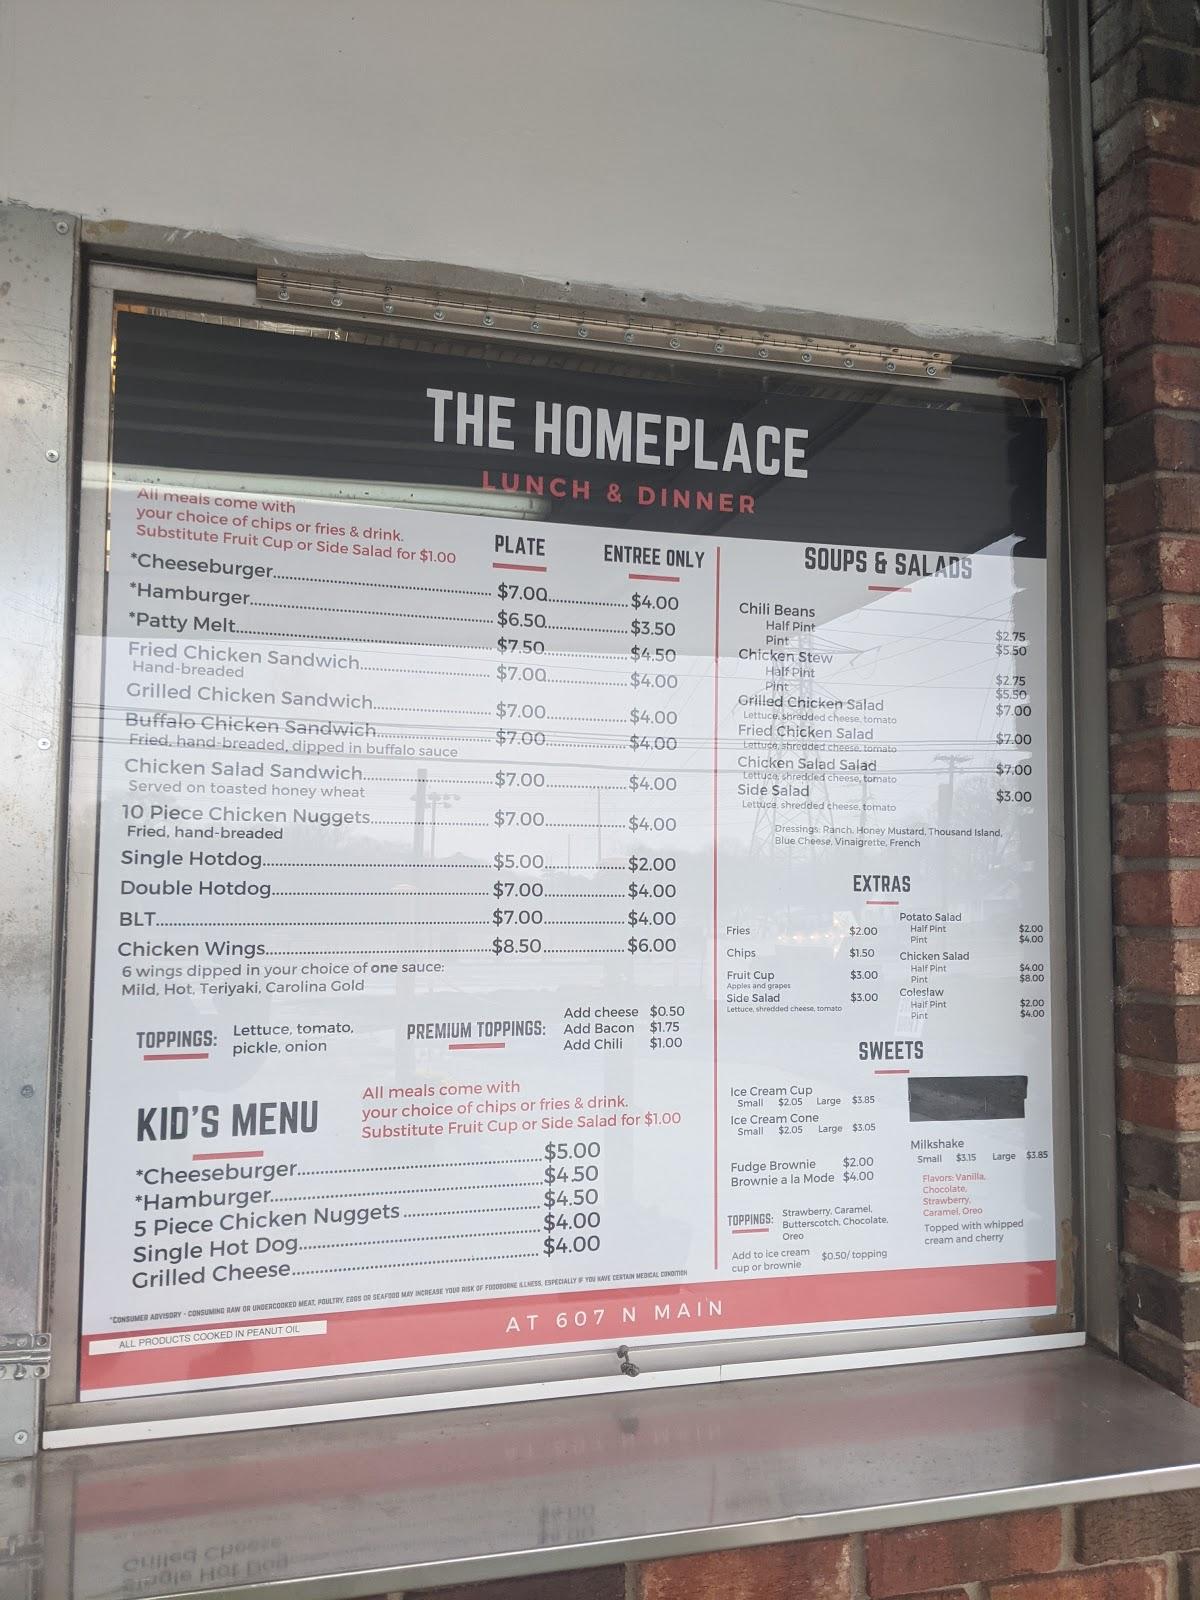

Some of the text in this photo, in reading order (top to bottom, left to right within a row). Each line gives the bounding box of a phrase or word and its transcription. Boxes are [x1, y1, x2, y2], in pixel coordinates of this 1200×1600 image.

[426, 388, 808, 479] THE HOMEPLACE
[483, 471, 756, 514] LUNCH & DINNER
[495, 535, 545, 556] PLATE
[605, 545, 705, 568] ENTREE ONLY
[805, 547, 972, 579] SOUPS & SALADS
[498, 582, 547, 601] $7.00
[631, 593, 679, 611] $4.00
[739, 603, 815, 617] Chili Beans
[193, 616, 236, 633] Melt
[497, 610, 546, 628] $6.50
[631, 619, 675, 637] $3.50
[996, 631, 1025, 643] $2.75
[739, 649, 833, 663] Chicken Stew
[995, 646, 1027, 657] $5.50
[133, 661, 244, 678] Hand-breaded
[129, 780, 366, 799] Served on toasted honey wheat
[738, 784, 809, 796] Side Salad
[996, 790, 1032, 802] $3.00
[775, 837, 795, 845] Blue
[889, 839, 920, 847] French
[121, 880, 272, 898] Double Hotdog
[854, 875, 911, 893] EXTRAS
[119, 912, 156, 926] BLT
[492, 907, 543, 925] $7.00
[628, 909, 676, 927] $4.00
[900, 913, 962, 922] Potato Salad
[726, 926, 750, 935] Fries
[850, 926, 877, 937] $2.00
[1019, 924, 1043, 933] $2.00
[492, 937, 542, 955] $8.50
[627, 936, 676, 953] $6.00
[1019, 935, 1043, 944] $4.00
[727, 949, 755, 959] Chips
[850, 948, 874, 958] $1.50
[900, 952, 969, 961] Chicken Salad
[727, 970, 774, 982] Fruit Cup
[851, 970, 878, 980] $3.00
[122, 980, 364, 996] Mild, Hot, Teriyaki, Carolina Gold
[900, 988, 943, 997] Coleslaw
[726, 993, 780, 1003] Side Salad
[851, 992, 878, 1002] $3.00
[564, 1007, 639, 1018] Add cheese
[650, 1005, 684, 1017] $0.50
[233, 1022, 354, 1037] Lettuce, tomato,
[407, 1020, 546, 1039] PREMIUM TOPPINGS:
[564, 1023, 634, 1034] Add Bacon
[650, 1021, 680, 1033] $1.75
[136, 1030, 218, 1048] TOPPINGS:
[563, 1039, 623, 1050] Add Chili
[650, 1037, 682, 1049] $1.00
[232, 1040, 327, 1057] pickle, onion
[859, 1041, 924, 1060] SWEETS
[730, 1086, 813, 1097] Ice Cream Cup
[362, 1096, 628, 1120] your choice of chips or fries & drink.
[232, 1100, 318, 1137] MENU
[731, 1113, 819, 1125] Ice Cream Cone
[911, 1139, 964, 1150] Milkshake
[545, 1141, 600, 1163] $5.00
[917, 1150, 1048, 1164] Small $3.15 Large $3.85
[731, 1160, 816, 1174] Fudge Brownie
[843, 1157, 874, 1168] $2.00
[544, 1164, 598, 1186] $4.50
[731, 1176, 777, 1187] Brownie
[790, 1175, 800, 1184] la
[804, 1173, 834, 1183] Mode
[843, 1171, 874, 1182] $4.00
[544, 1188, 598, 1209] $4.50
[728, 1214, 774, 1226] TOPPINGS:
[783, 1207, 832, 1219] Strawberry,
[134, 1204, 400, 1237] 5 Piece Chicken Nuggets
[544, 1211, 600, 1232] $4.00
[783, 1232, 804, 1241] Oreo
[133, 1237, 298, 1264] Single Hot Dog
[543, 1235, 600, 1257] $4.00
[132, 1263, 291, 1288] Grilled Cheese
[506, 1300, 722, 1333] AT 607 N MAIN
[119, 1324, 300, 1349] ALL PRODUCTS COOKED IN PEANUT OIL
